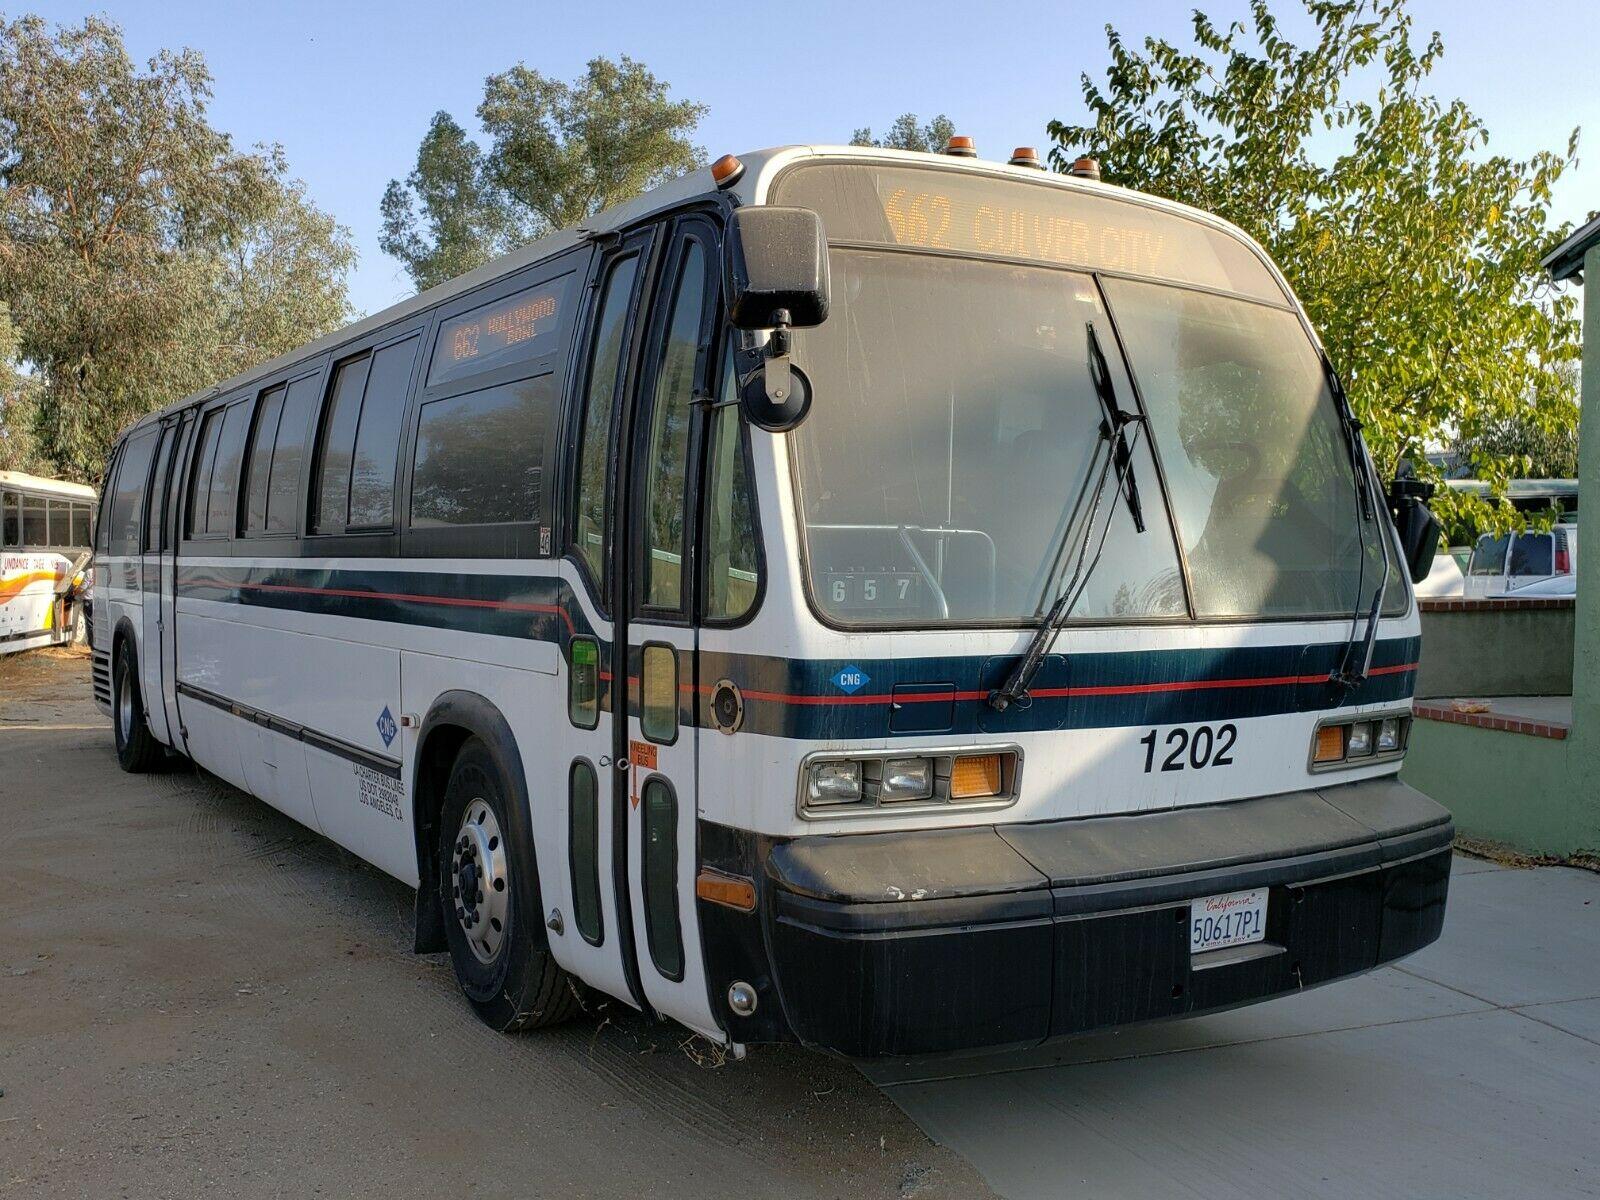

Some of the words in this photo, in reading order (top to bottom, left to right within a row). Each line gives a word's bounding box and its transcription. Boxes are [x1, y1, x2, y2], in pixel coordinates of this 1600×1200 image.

[975, 206, 1089, 264] CULVER
[1099, 226, 1164, 274] CITY
[840, 673, 860, 686] CNG
[380, 716, 395, 737] CNG
[1140, 723, 1238, 774] 1202
[637, 754, 649, 768] BUS
[1206, 896, 1254, 913] California
[1193, 909, 1260, 944] 50617P1
